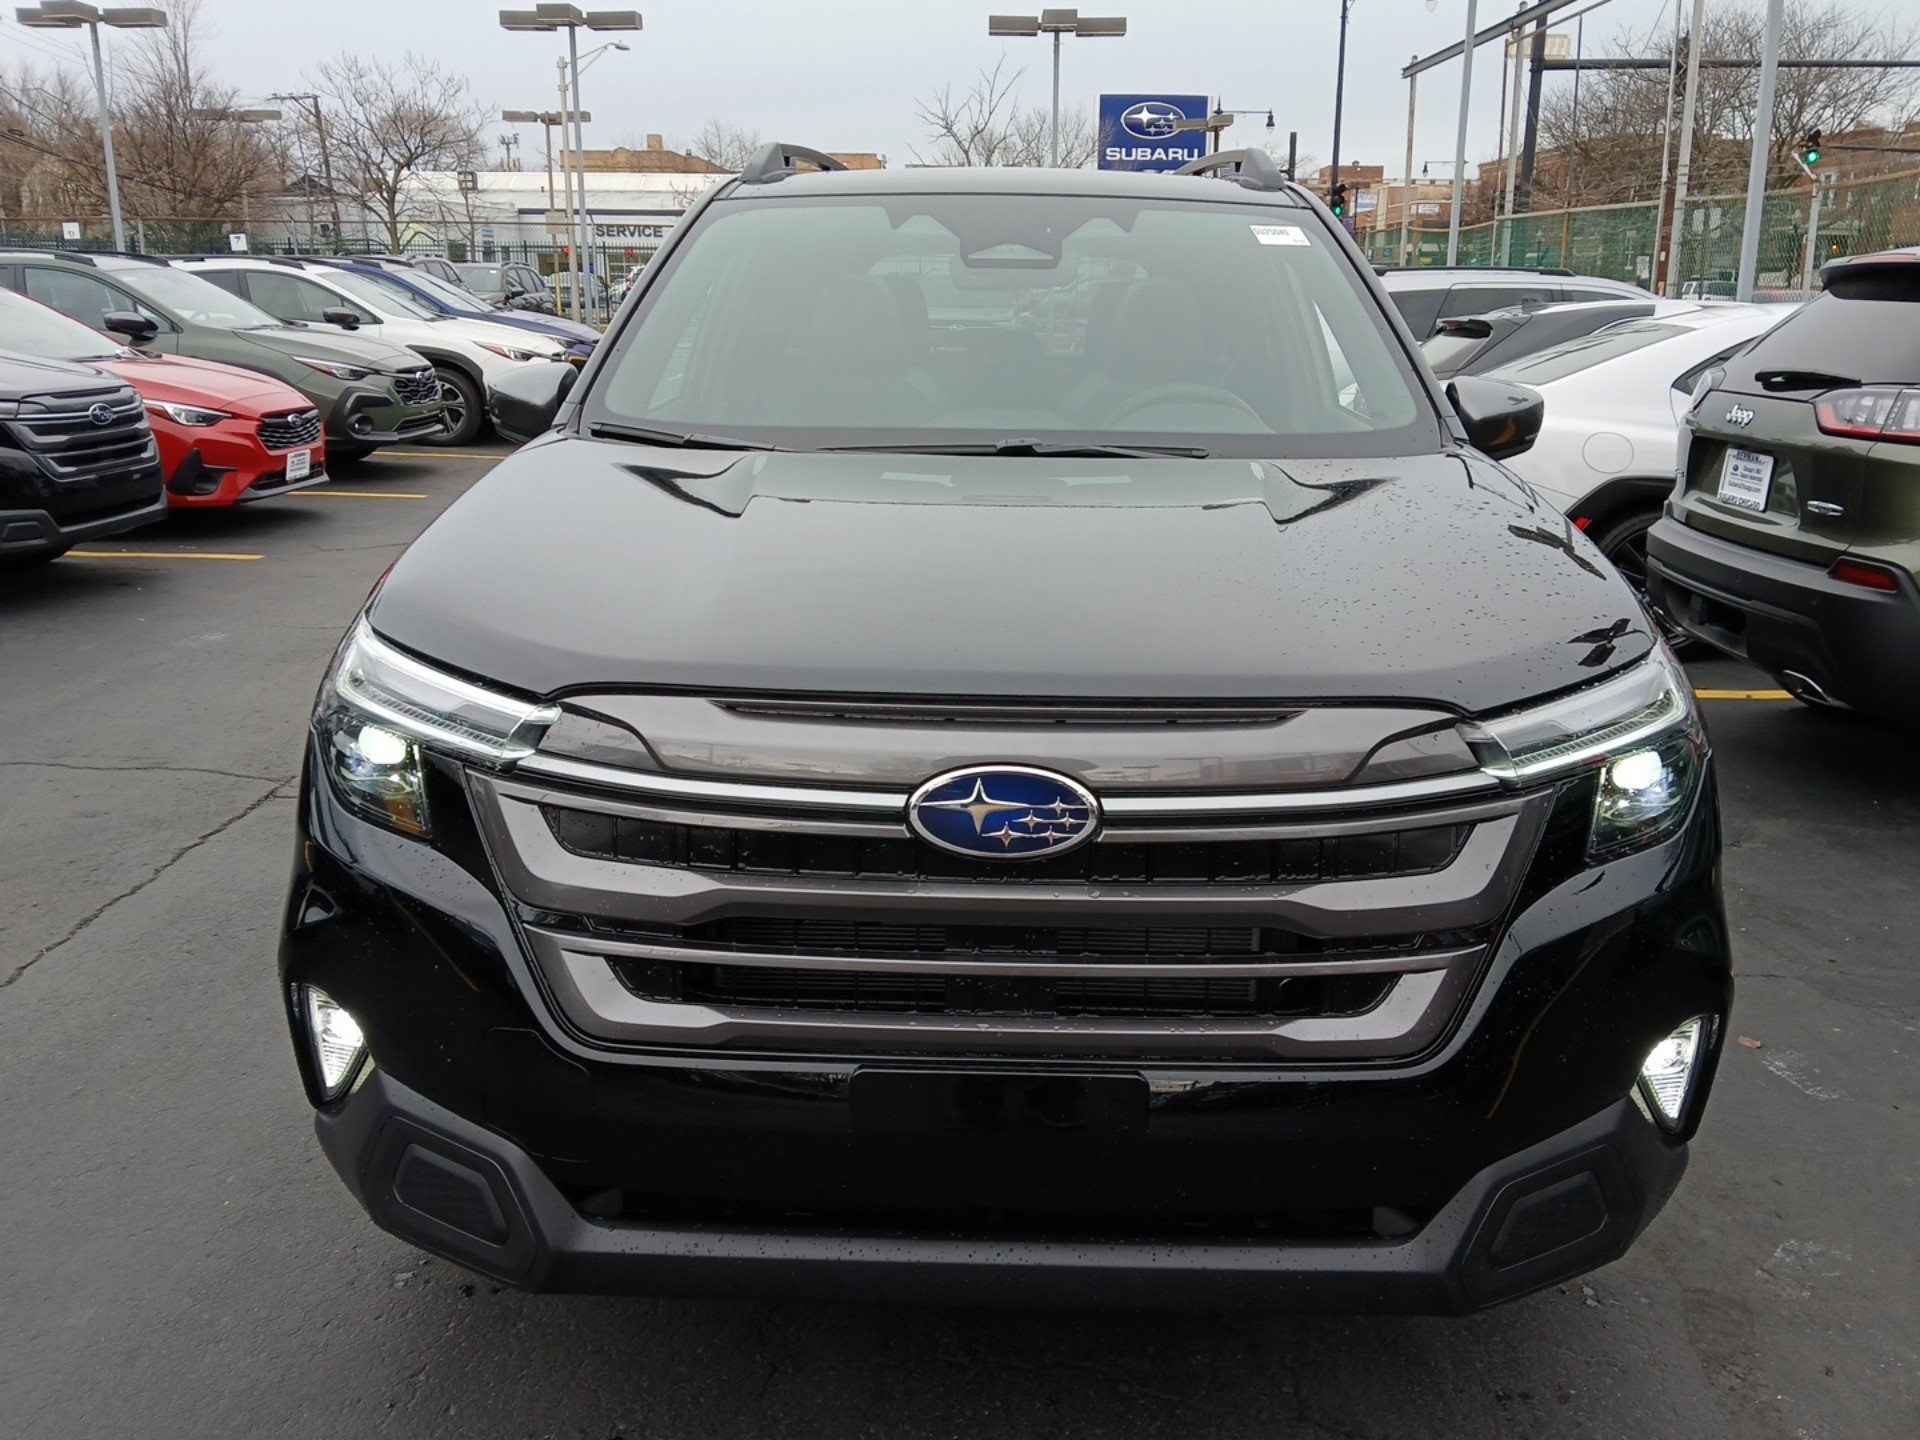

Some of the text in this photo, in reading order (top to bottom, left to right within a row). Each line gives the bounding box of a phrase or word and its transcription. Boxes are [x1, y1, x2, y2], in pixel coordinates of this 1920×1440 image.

[1105, 147, 1198, 161] SUBARU
[596, 225, 663, 238] SERVICE
[1726, 404, 1754, 427] Jeep
